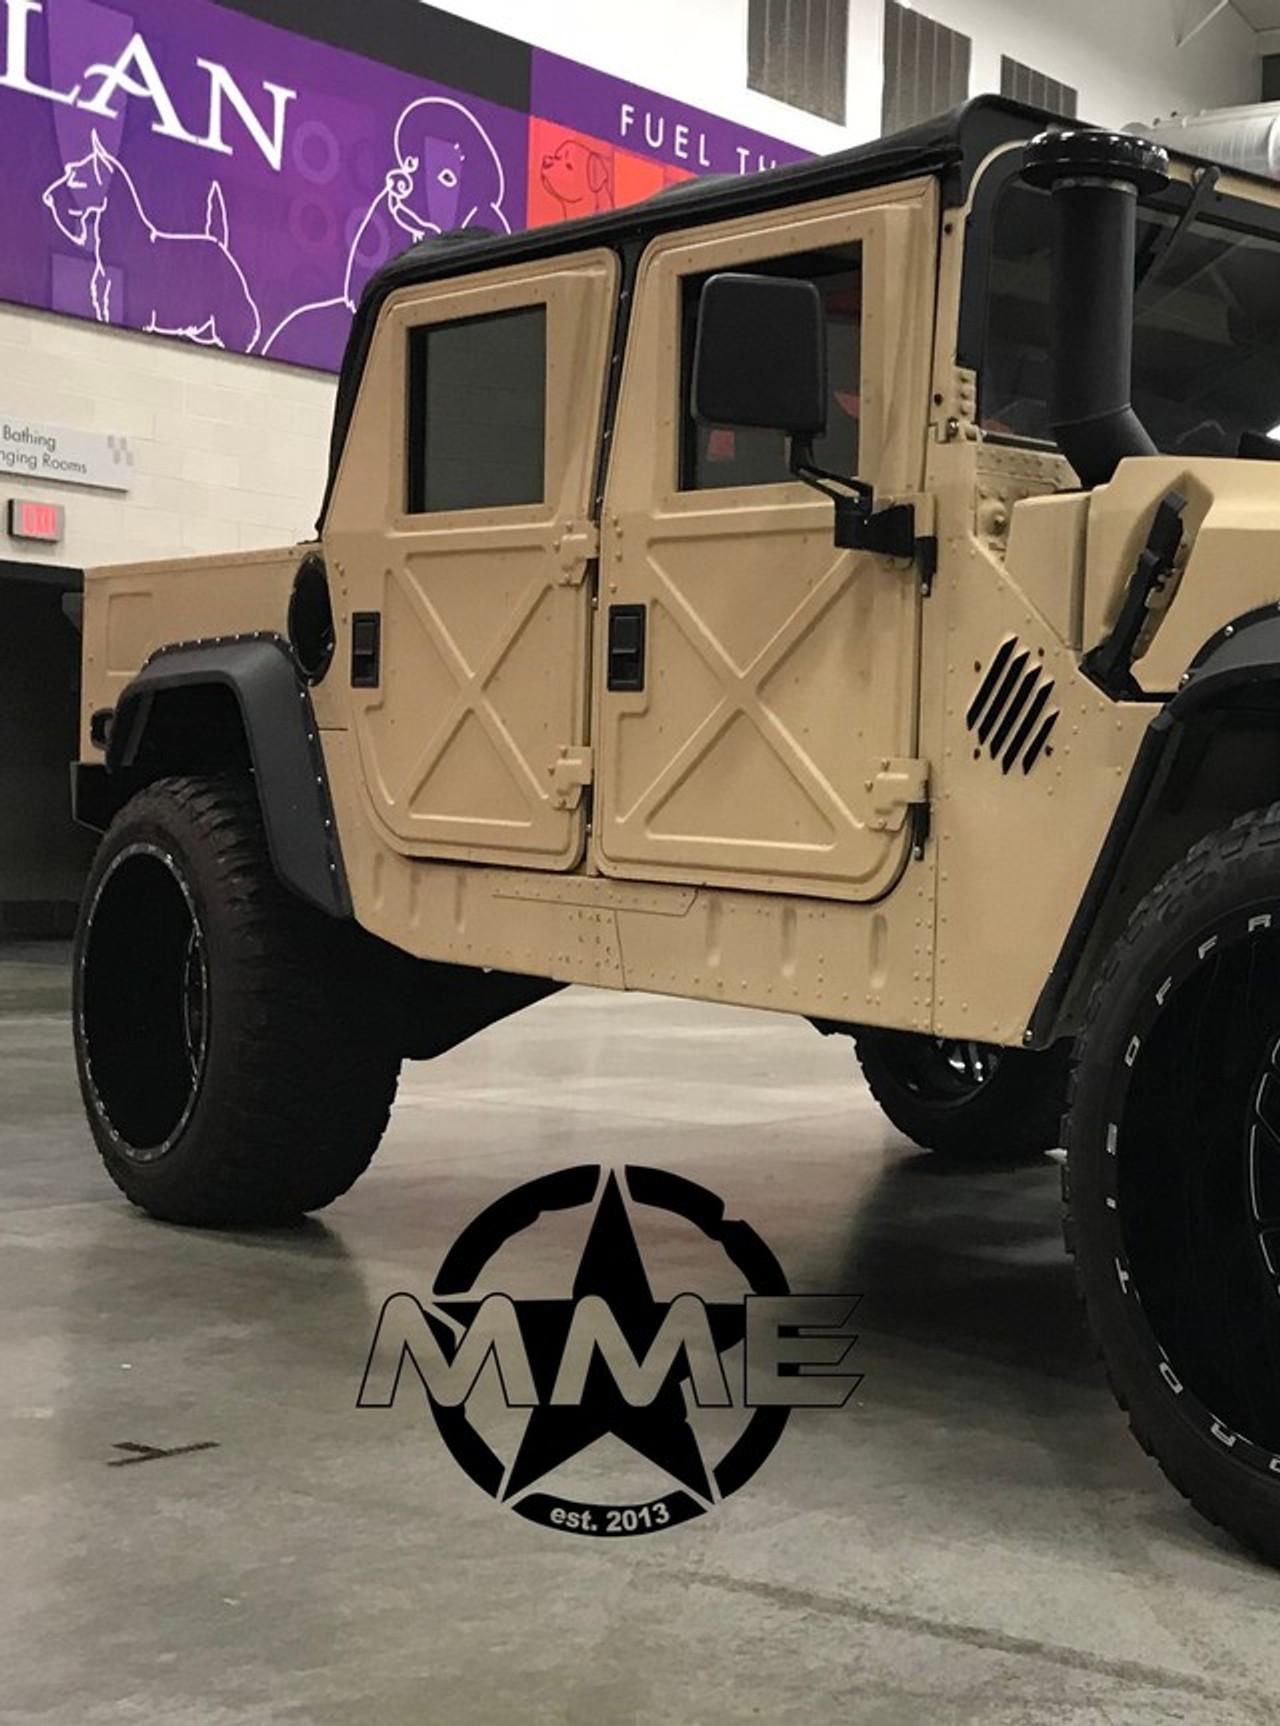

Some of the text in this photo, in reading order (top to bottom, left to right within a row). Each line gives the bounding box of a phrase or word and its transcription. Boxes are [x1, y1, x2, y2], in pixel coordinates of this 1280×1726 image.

[0, 0, 297, 171] LAN
[621, 103, 710, 167] FUEL
[3, 424, 57, 453] Bathing
[42, 451, 88, 474] Rooms
